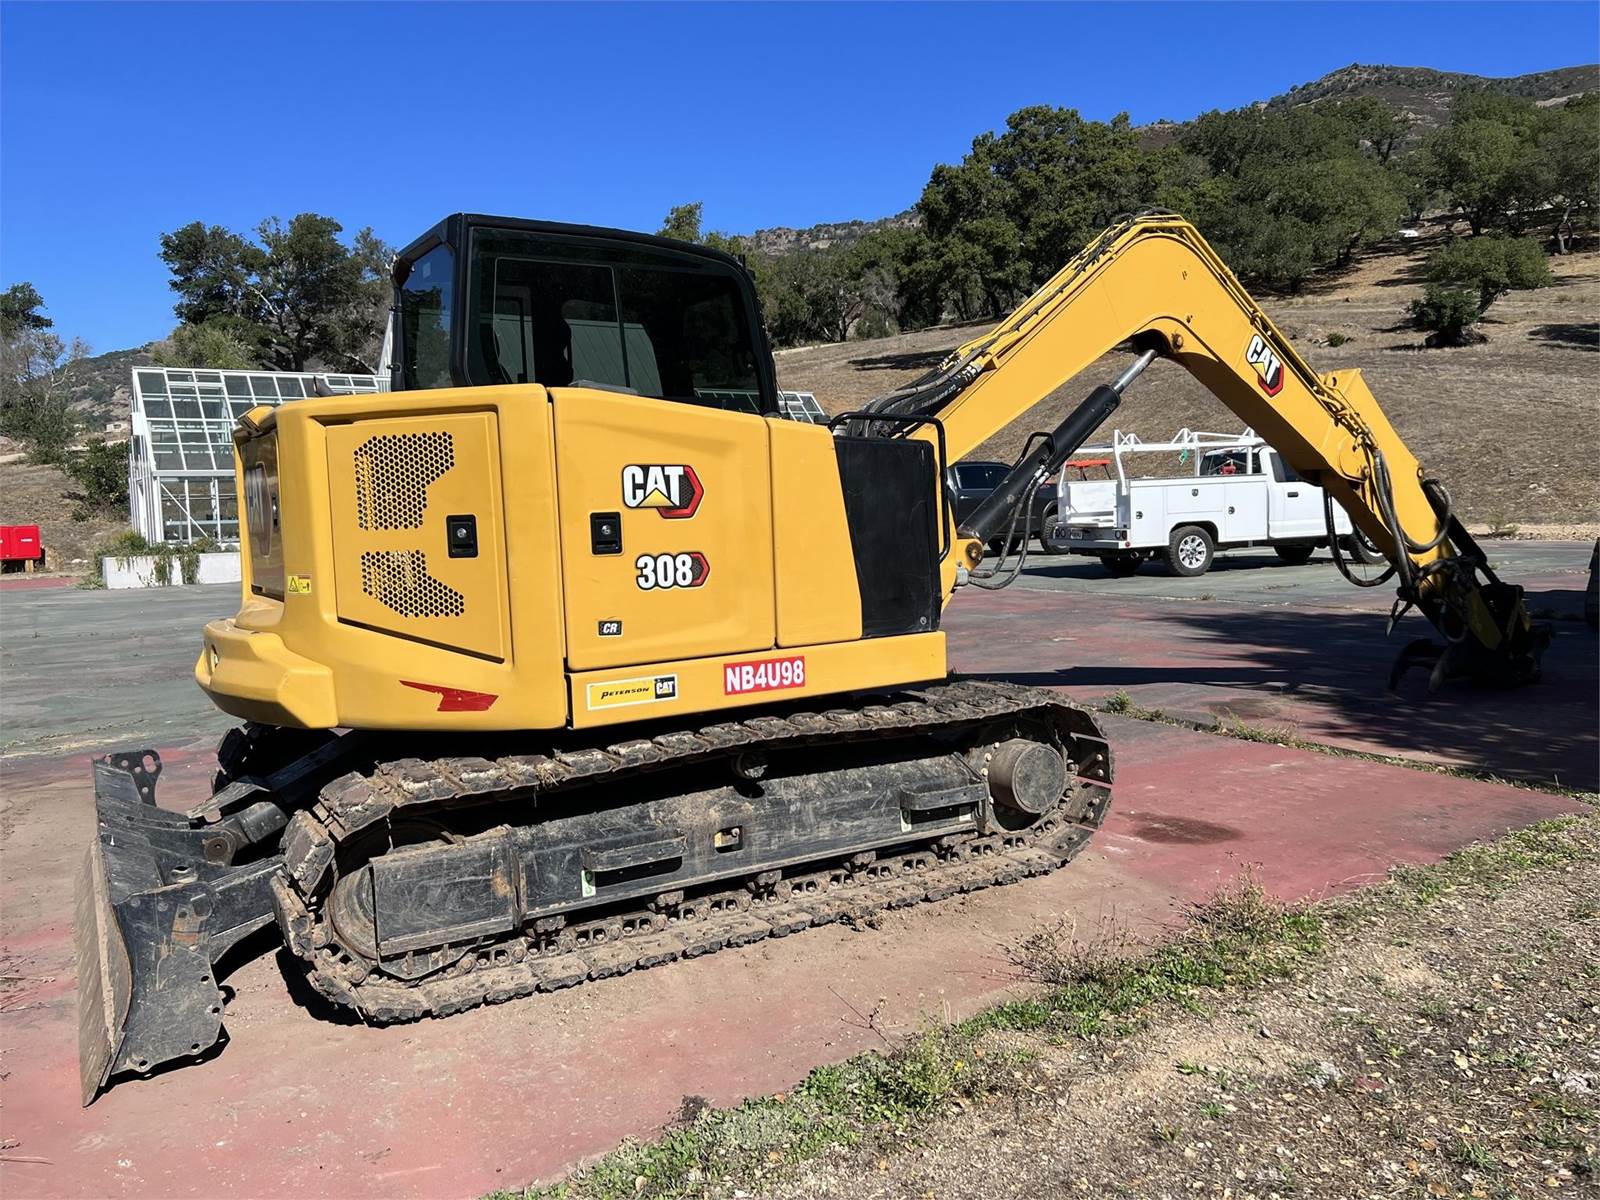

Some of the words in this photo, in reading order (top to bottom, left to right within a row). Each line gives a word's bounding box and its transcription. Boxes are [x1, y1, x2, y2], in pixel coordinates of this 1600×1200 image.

[1246, 334, 1281, 385] CAT
[622, 465, 684, 508] CAT
[636, 554, 693, 589] 308
[603, 622, 618, 634] CR
[601, 687, 650, 700] PETERSON
[656, 680, 674, 695] CAT
[726, 659, 804, 693] NB4U98
